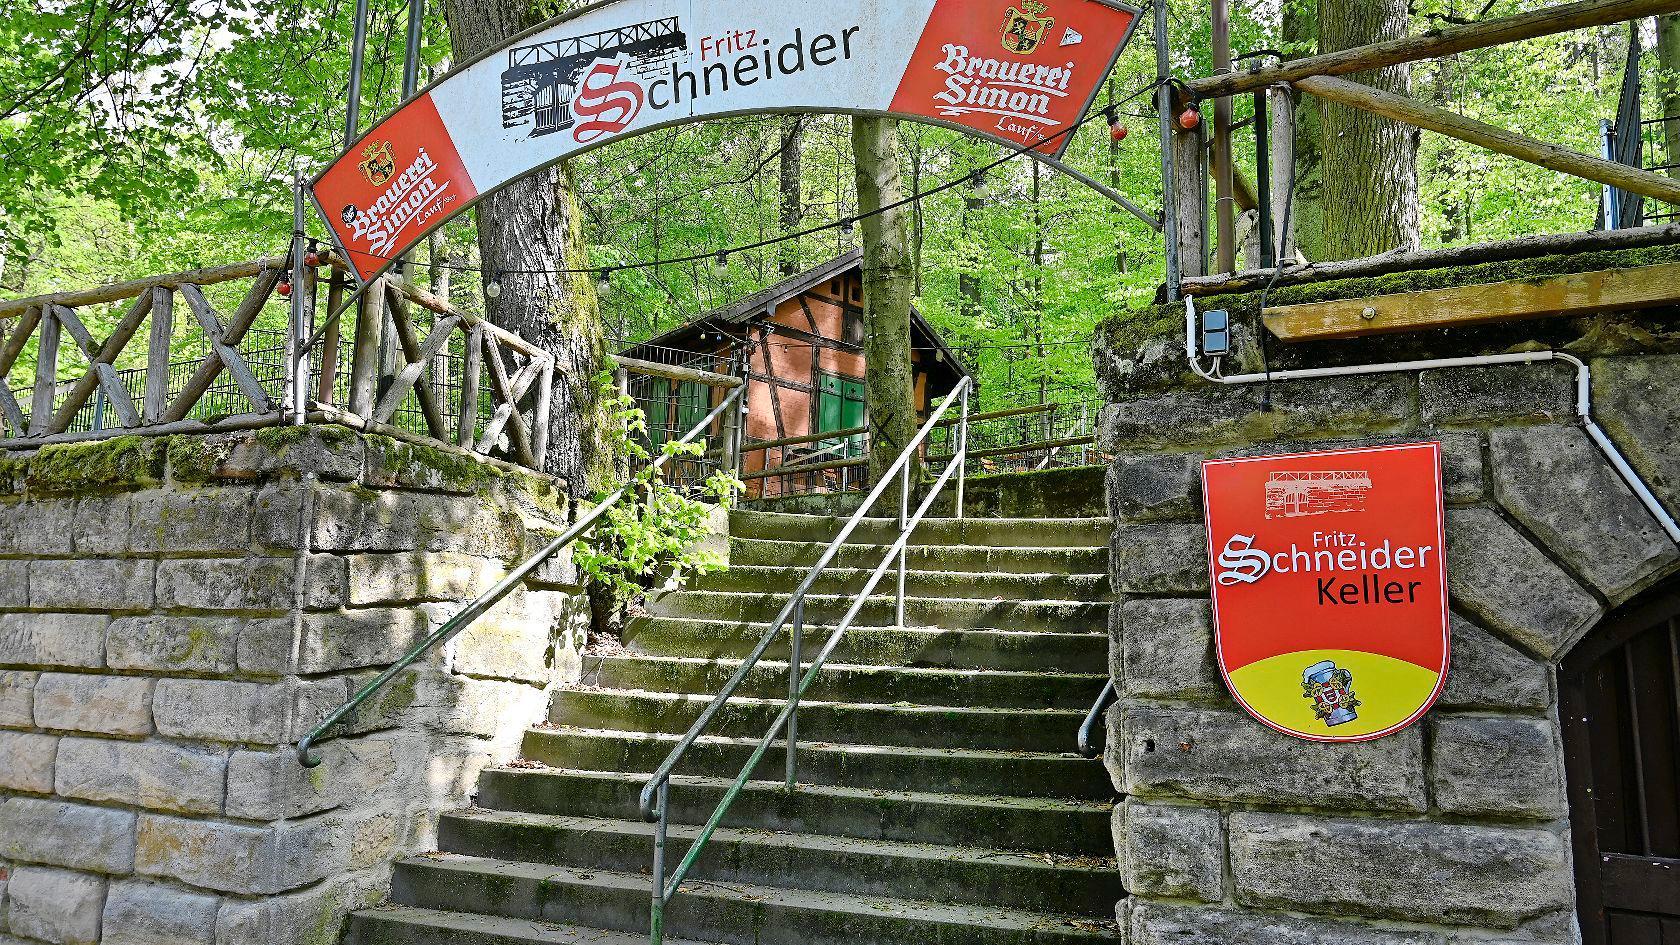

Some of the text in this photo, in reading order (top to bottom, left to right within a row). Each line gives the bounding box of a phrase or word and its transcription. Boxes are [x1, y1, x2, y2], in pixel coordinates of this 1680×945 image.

[701, 29, 757, 61] Fritz
[933, 43, 1075, 90] Brauerei
[573, 26, 859, 143] Schneider
[933, 74, 1049, 115] Simon
[346, 147, 433, 241] Brauerei
[366, 177, 437, 254] Simon
[1217, 533, 1432, 585] Schneider
[1313, 531, 1356, 547] Fritz
[1317, 573, 1421, 605] Keller
